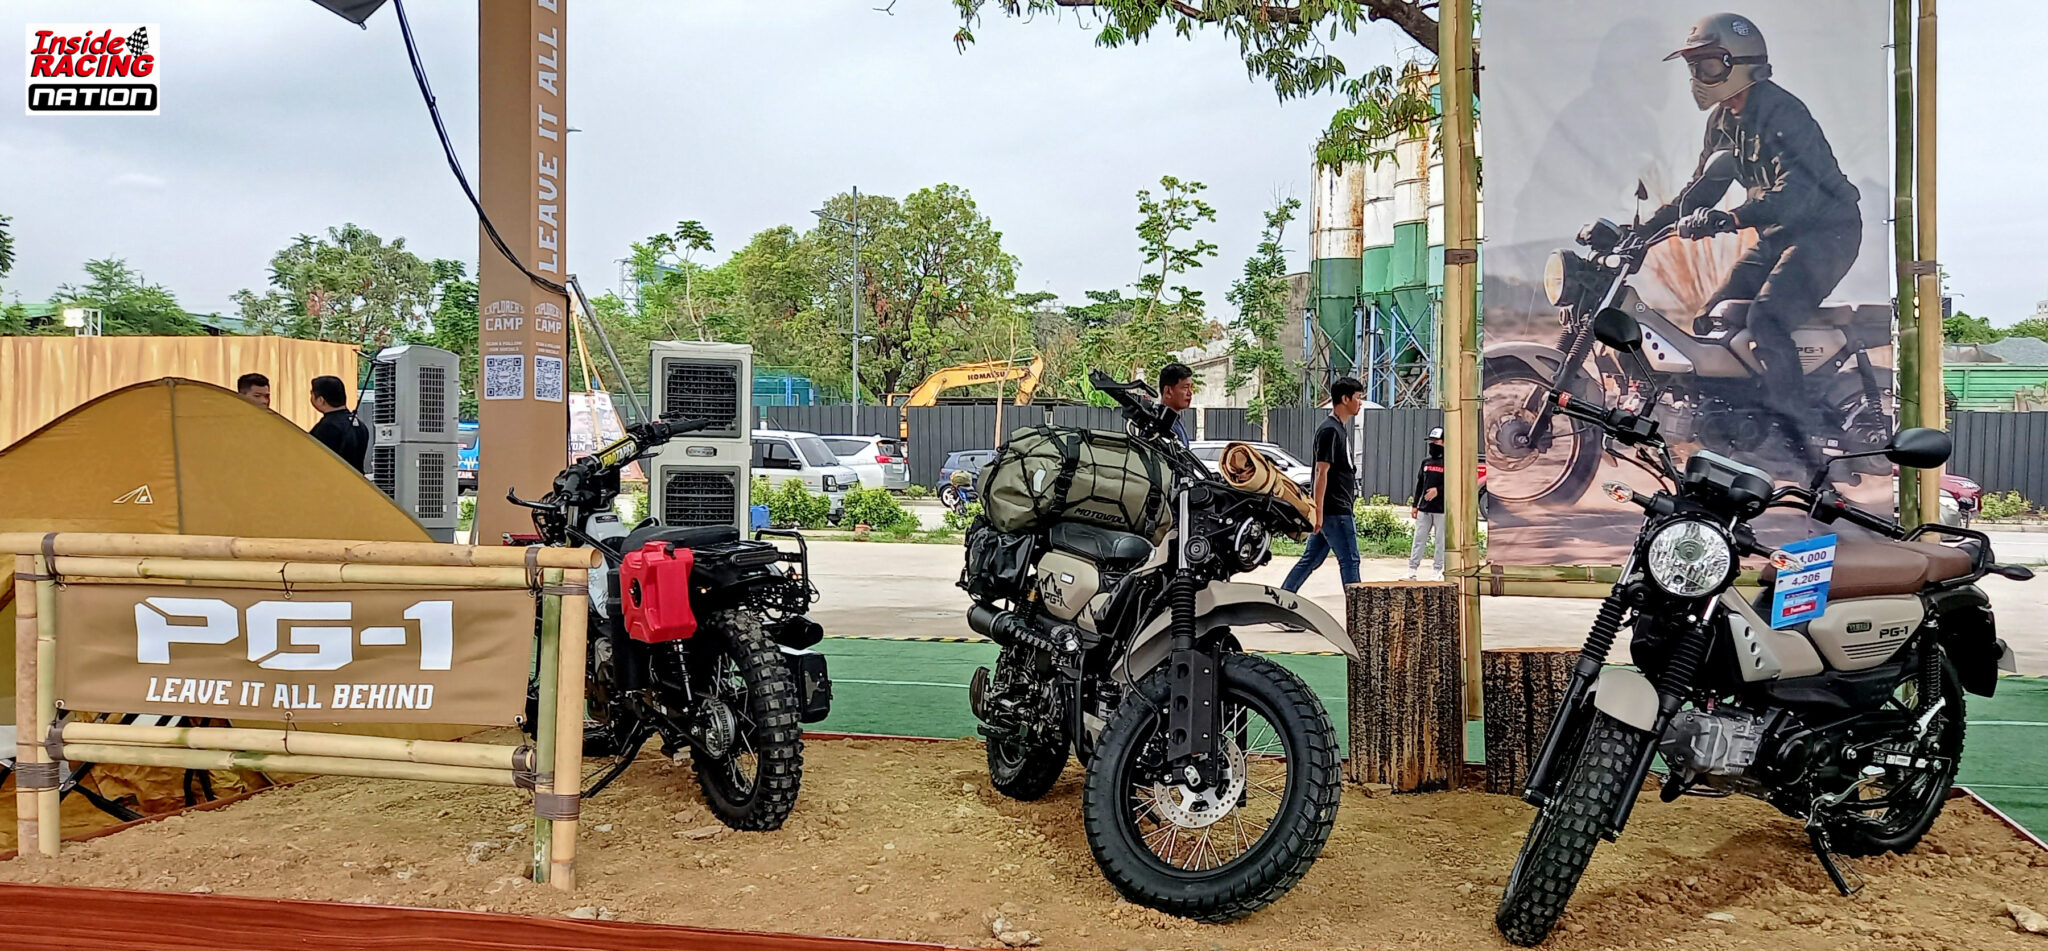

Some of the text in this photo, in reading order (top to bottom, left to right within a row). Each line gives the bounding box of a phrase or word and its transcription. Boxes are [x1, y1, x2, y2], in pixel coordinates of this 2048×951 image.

[538, 27, 557, 96] ALL
[538, 105, 557, 141] IT
[538, 152, 557, 274] LEAVE
[485, 318, 523, 331] CAMP
[535, 318, 562, 334] CAMP
[1074, 507, 1127, 524] MOTOWOL
[1791, 572, 1821, 586] 4,206
[134, 597, 453, 671] PG-1
[1879, 626, 1909, 639] PG-1
[146, 677, 434, 710] LEAVE IT ALL BEHIND
